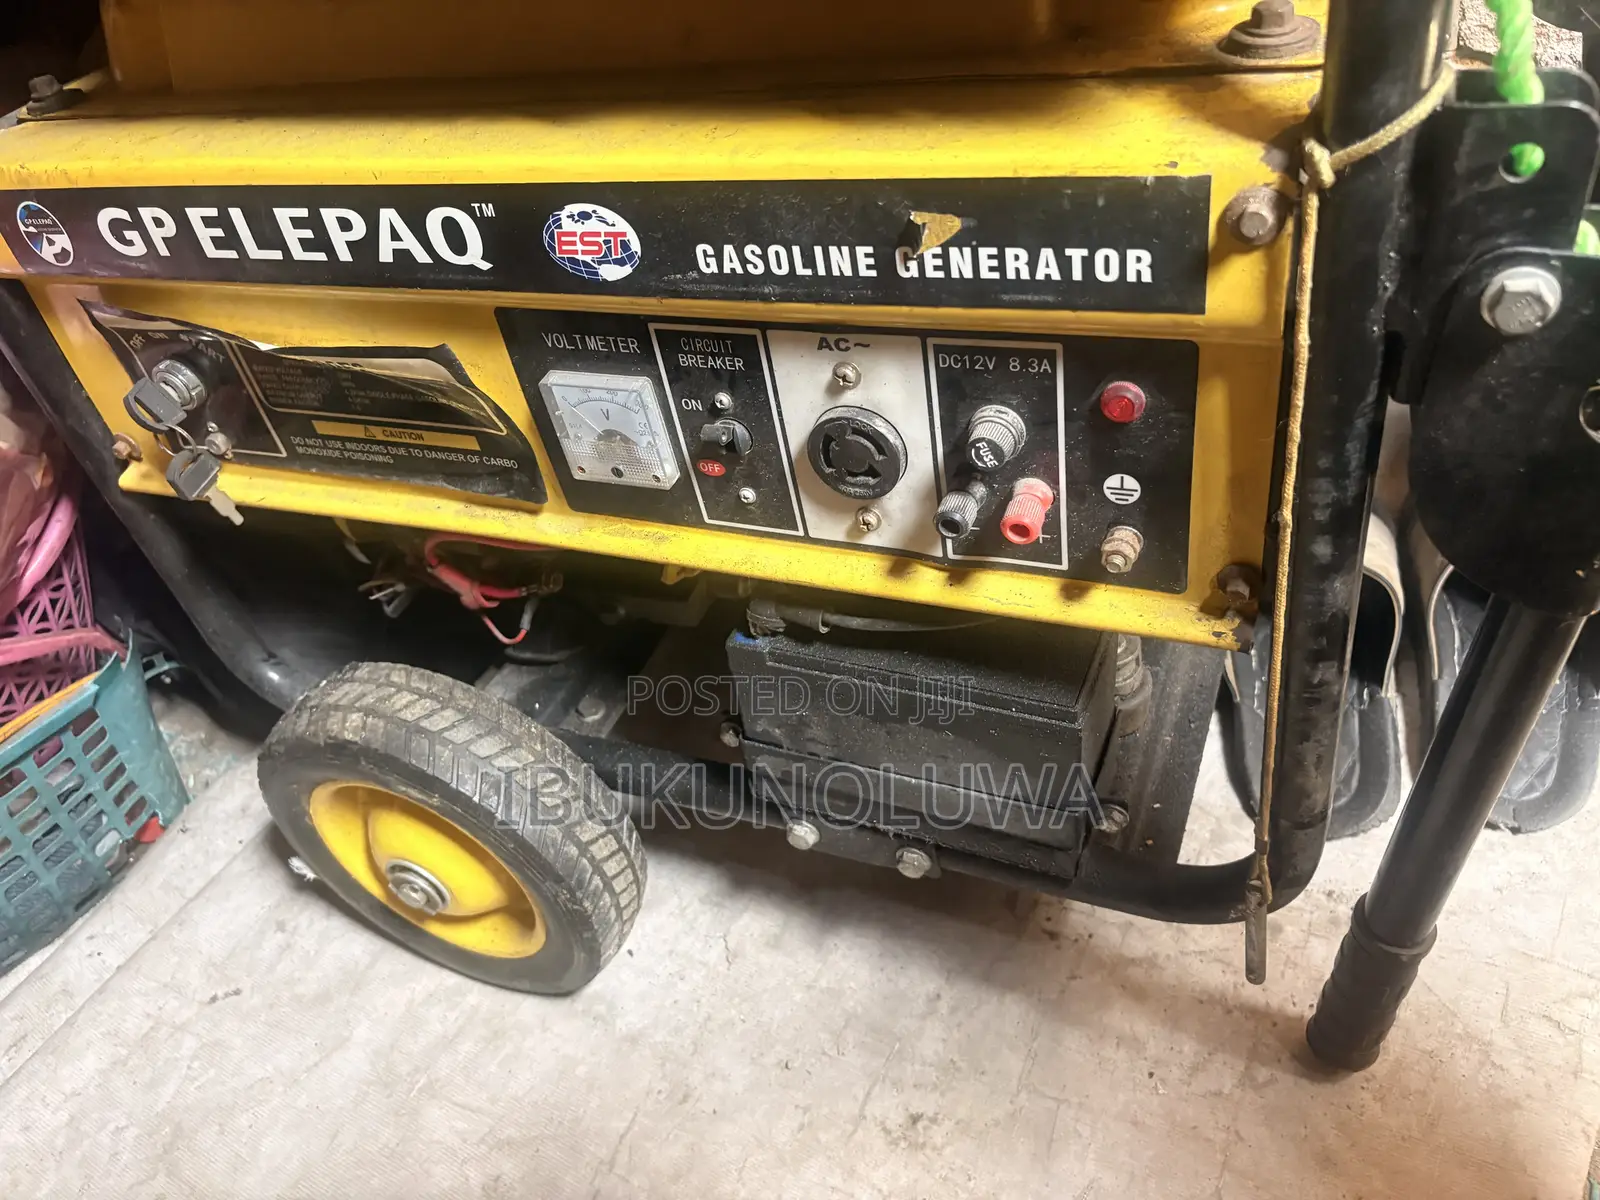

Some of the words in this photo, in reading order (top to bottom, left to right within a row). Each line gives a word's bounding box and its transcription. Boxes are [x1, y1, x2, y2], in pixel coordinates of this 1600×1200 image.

[97, 207, 177, 257] GP
[184, 206, 494, 271] ELEPAQ
[556, 230, 628, 256] EST
[695, 243, 878, 278] GASOLINE
[895, 246, 1153, 283] GENERATOR
[680, 337, 733, 354] CIRCUIT
[678, 353, 746, 371] BREAKER
[938, 353, 996, 371] DC12V
[1008, 357, 1052, 374] 8.3A
[681, 398, 703, 411] ON
[600, 408, 610, 421] V
[382, 429, 425, 442] CAUTION
[849, 419, 874, 435] LOCK
[290, 436, 304, 446] DO
[305, 437, 324, 448] NOT
[326, 439, 344, 450] USE
[345, 441, 387, 454] INDOORS
[389, 446, 408, 456] DUE
[410, 448, 423, 458] TO
[424, 450, 465, 463] DANGER
[467, 454, 481, 464] OF
[483, 456, 518, 469] CARBO
[296, 445, 342, 459] MONOXIDE
[343, 451, 394, 464] POISONING
[975, 441, 999, 468] FUSE
[700, 461, 721, 473] OFF
